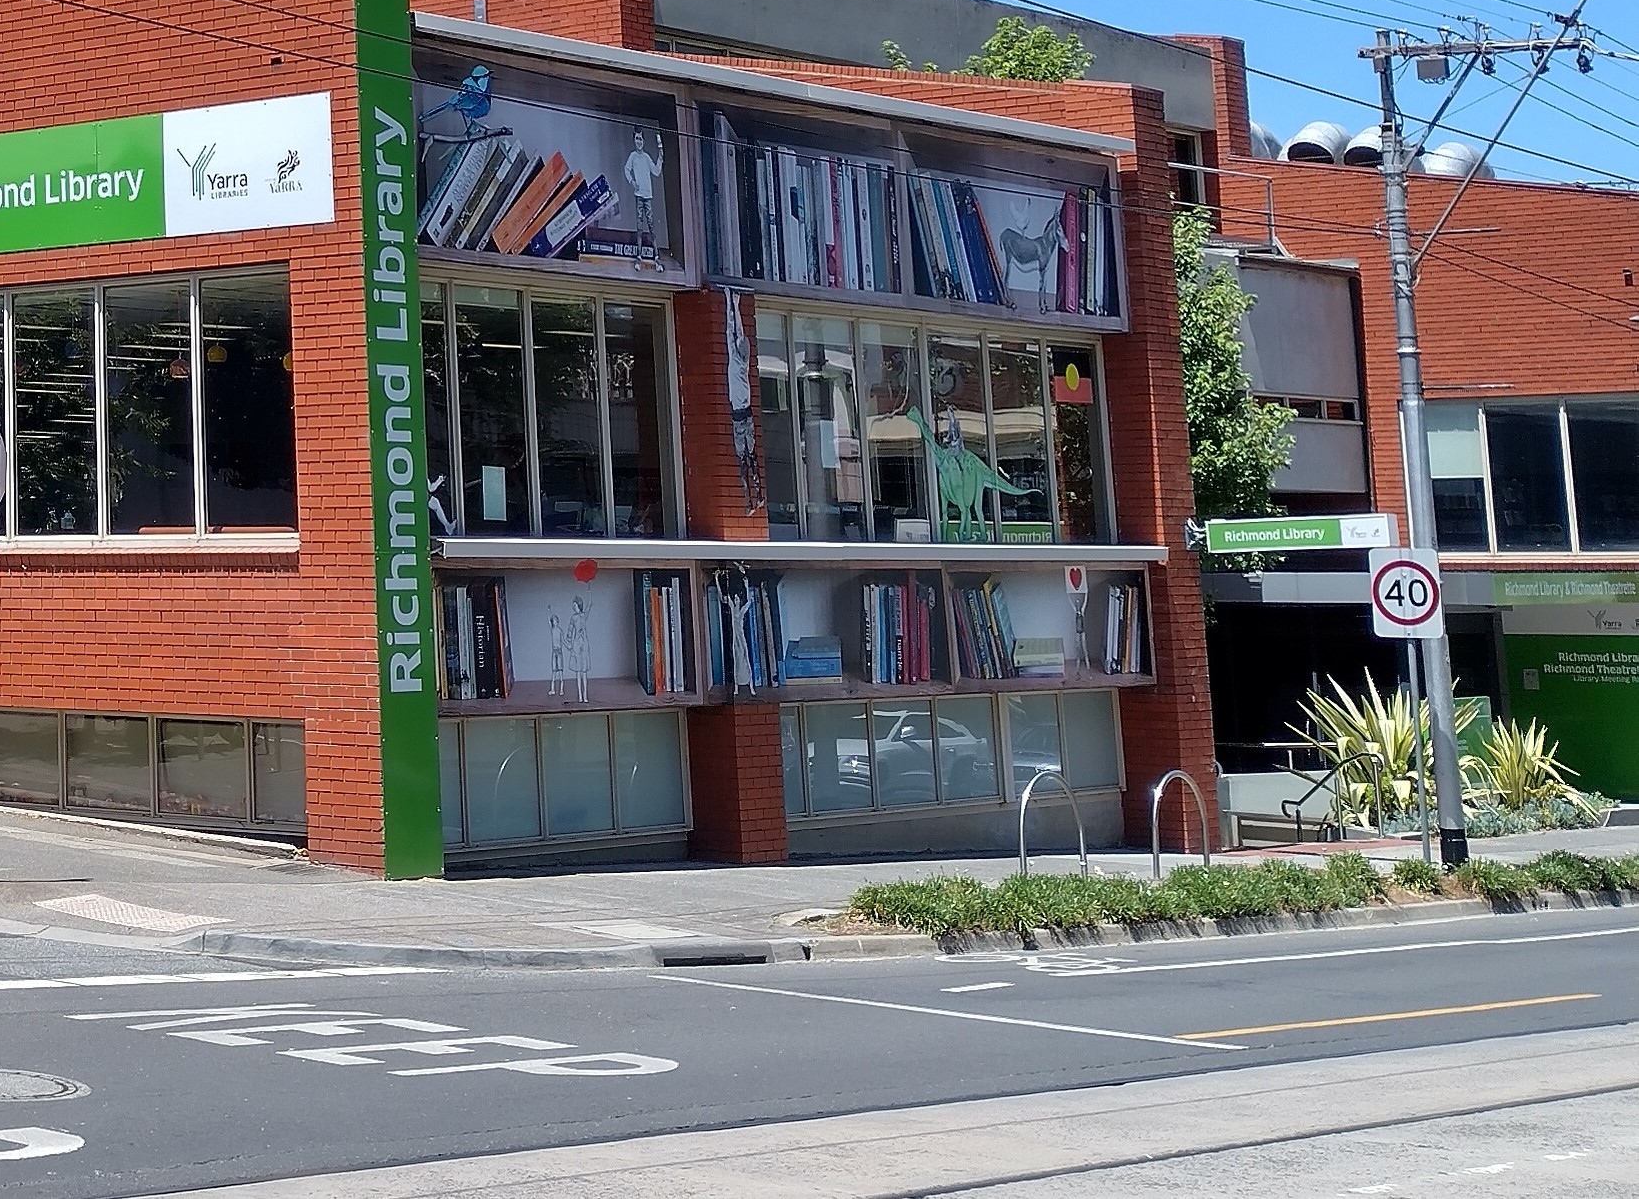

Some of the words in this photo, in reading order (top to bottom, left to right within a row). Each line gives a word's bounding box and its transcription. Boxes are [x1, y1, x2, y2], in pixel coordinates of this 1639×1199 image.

[45, 168, 144, 204] Library
[207, 172, 248, 190] Yarra
[210, 189, 249, 200] LIBRARIES
[373, 106, 409, 342] Library
[376, 361, 423, 694] Richmond
[1224, 528, 1281, 543] Richmond
[1282, 527, 1325, 541] Library
[1384, 578, 1428, 607] 40
[1504, 581, 1539, 595] Richmond
[1539, 581, 1564, 598] Library
[1565, 581, 1571, 595] &
[1571, 581, 1603, 595] Richmond
[1602, 620, 1623, 628] Yarra
[475, 615, 486, 668] Historian
[1558, 652, 1609, 662] Richmond
[1543, 664, 1595, 674] Richmond
[63, 1002, 679, 1076] KEEP
